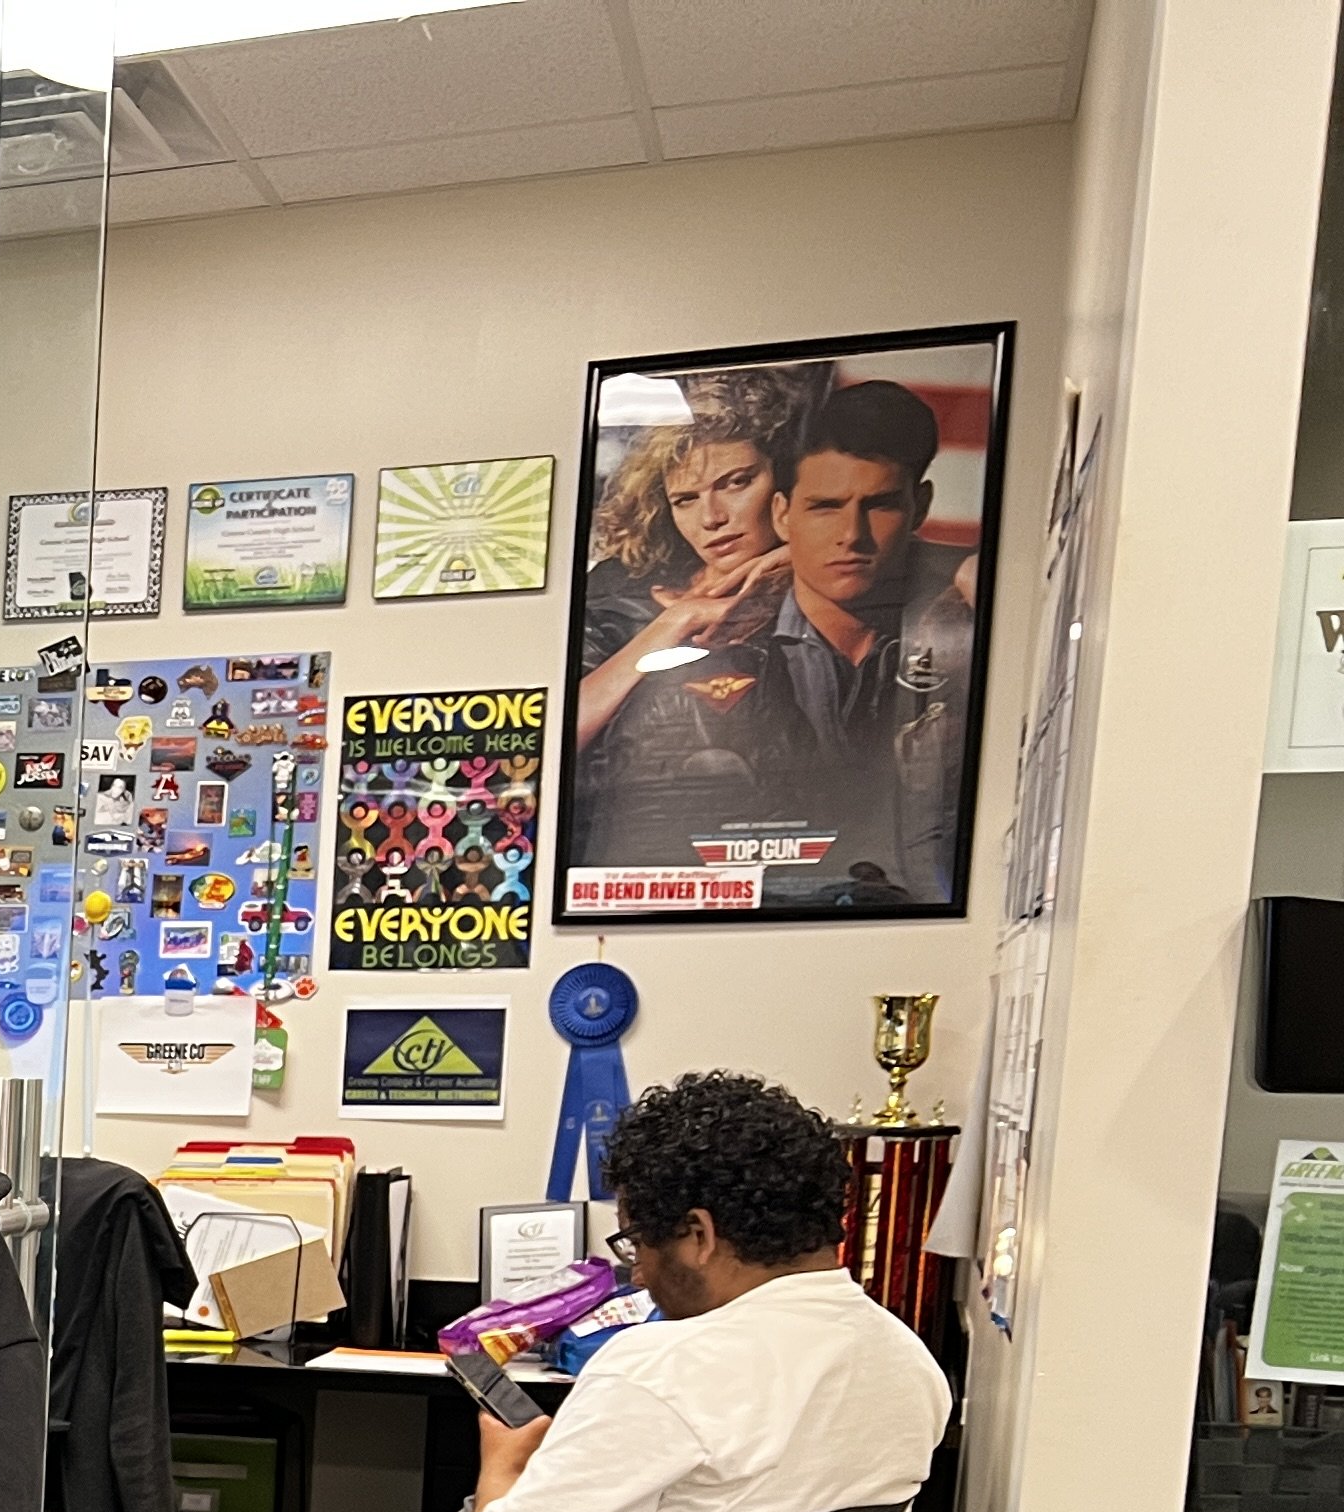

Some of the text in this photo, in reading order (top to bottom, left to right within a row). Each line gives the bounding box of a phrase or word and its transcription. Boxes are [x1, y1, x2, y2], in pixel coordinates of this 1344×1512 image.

[230, 487, 311, 503] CERTIFICATE
[226, 506, 316, 519] PARTICIPATION
[346, 693, 543, 735] EVERYONE
[81, 746, 113, 762] SAV
[349, 733, 537, 758] IS WELCOME HERE
[726, 838, 800, 861] TOP GUN
[573, 880, 754, 900] BIG BEND RIVER TOURS
[334, 905, 529, 942] EVERYONE
[363, 943, 497, 968] BELONGS
[146, 1043, 206, 1060] GREENE CO
